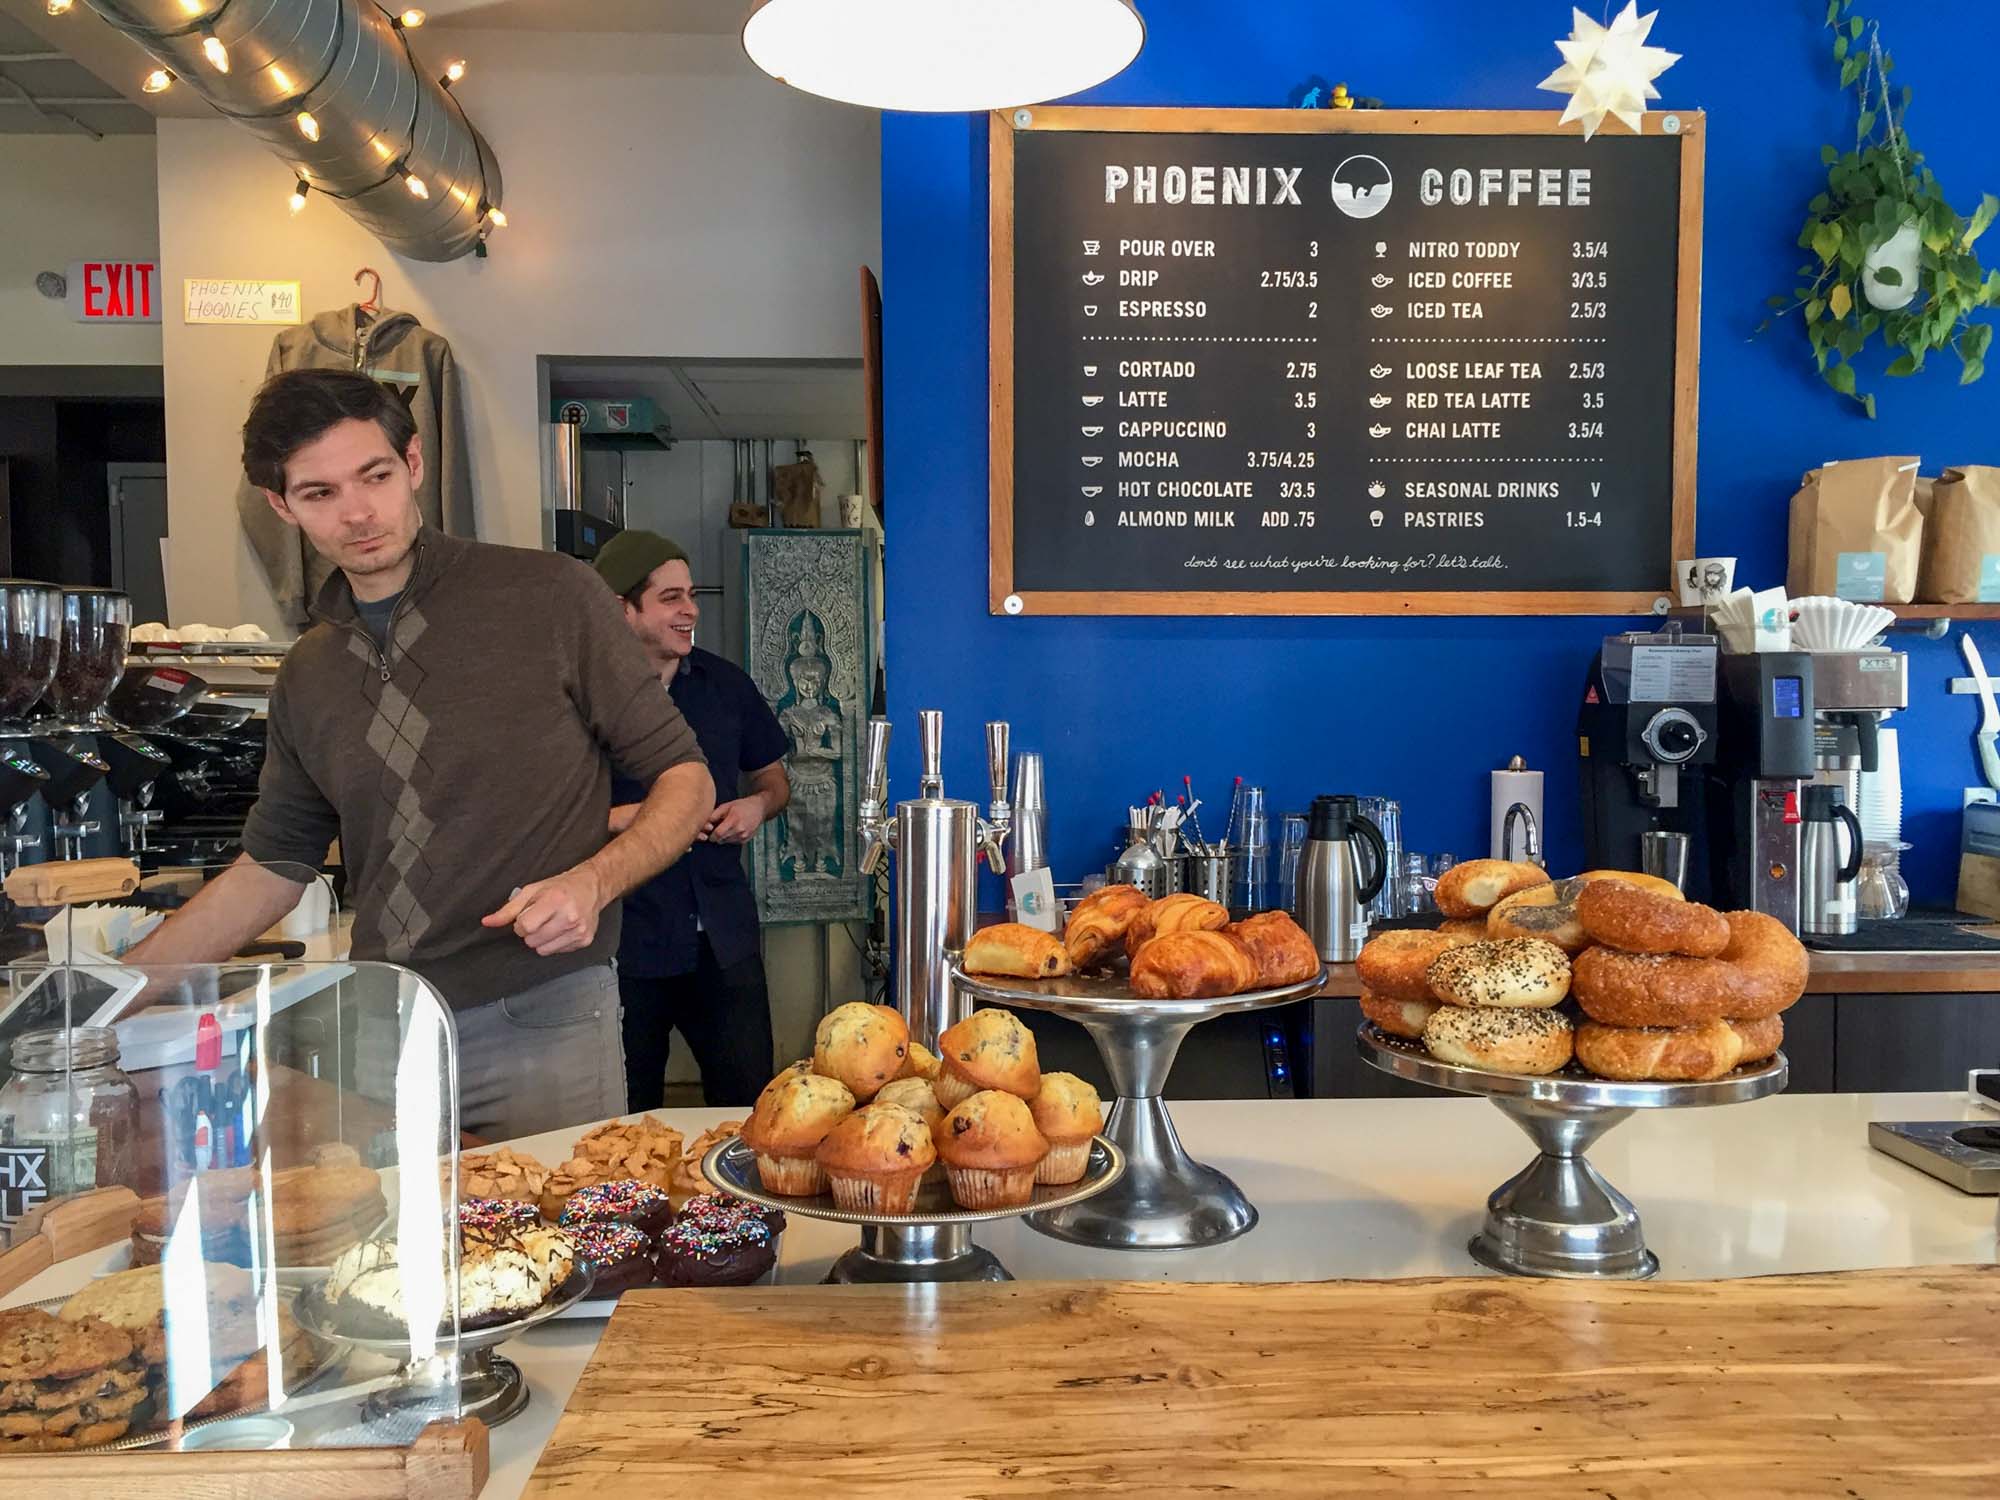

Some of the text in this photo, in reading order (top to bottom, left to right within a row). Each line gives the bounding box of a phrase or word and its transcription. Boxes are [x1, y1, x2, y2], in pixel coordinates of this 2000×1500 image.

[1105, 165, 1592, 207] PHOENIX COFFEE
[1119, 239, 1319, 258] POUR OVER 3
[1408, 241, 1609, 259] NITRO TODDY 3.5/4
[1119, 269, 1318, 288] DRIP 2.75/3.5
[1408, 271, 1607, 289] ICED COFFEE 3/3.5
[84, 263, 154, 317] EXIT
[191, 280, 265, 297] PHOENIX
[271, 291, 293, 309] $40
[189, 300, 262, 320] HOODIES
[1119, 300, 1318, 319] ESPRESSO 2
[1407, 301, 1607, 319] ICED TEA 2.5/3
[1119, 360, 1317, 379] CORTADO 2.75
[1406, 362, 1605, 380] LOOSE LEAF TEA 2.5/3
[1118, 391, 1317, 409] LATTE 3.5
[1406, 392, 1604, 409] RED TEA LATTE 3.5
[1118, 421, 1316, 439] CAPPUCCINO 3
[1405, 422, 1604, 439] CHAI LATTE 3.5/4
[1118, 451, 1315, 469] MOCHA 3.75/4.25
[1118, 481, 1316, 498] HOT CHOCOLATE 3/3.5
[1404, 481, 1601, 498] SEASONAL DRINKS V
[1117, 510, 1315, 528] ALMOND MILK ADD .75
[1404, 511, 1602, 528] PASTRIES 1.5-4
[1223, 558, 1247, 569] see
[1249, 555, 1289, 569] what
[1291, 555, 1338, 573] you're
[1340, 555, 1401, 574] looking
[1402, 553, 1436, 572] for?
[1436, 554, 1467, 569] let's
[1469, 554, 1509, 569] talk.
